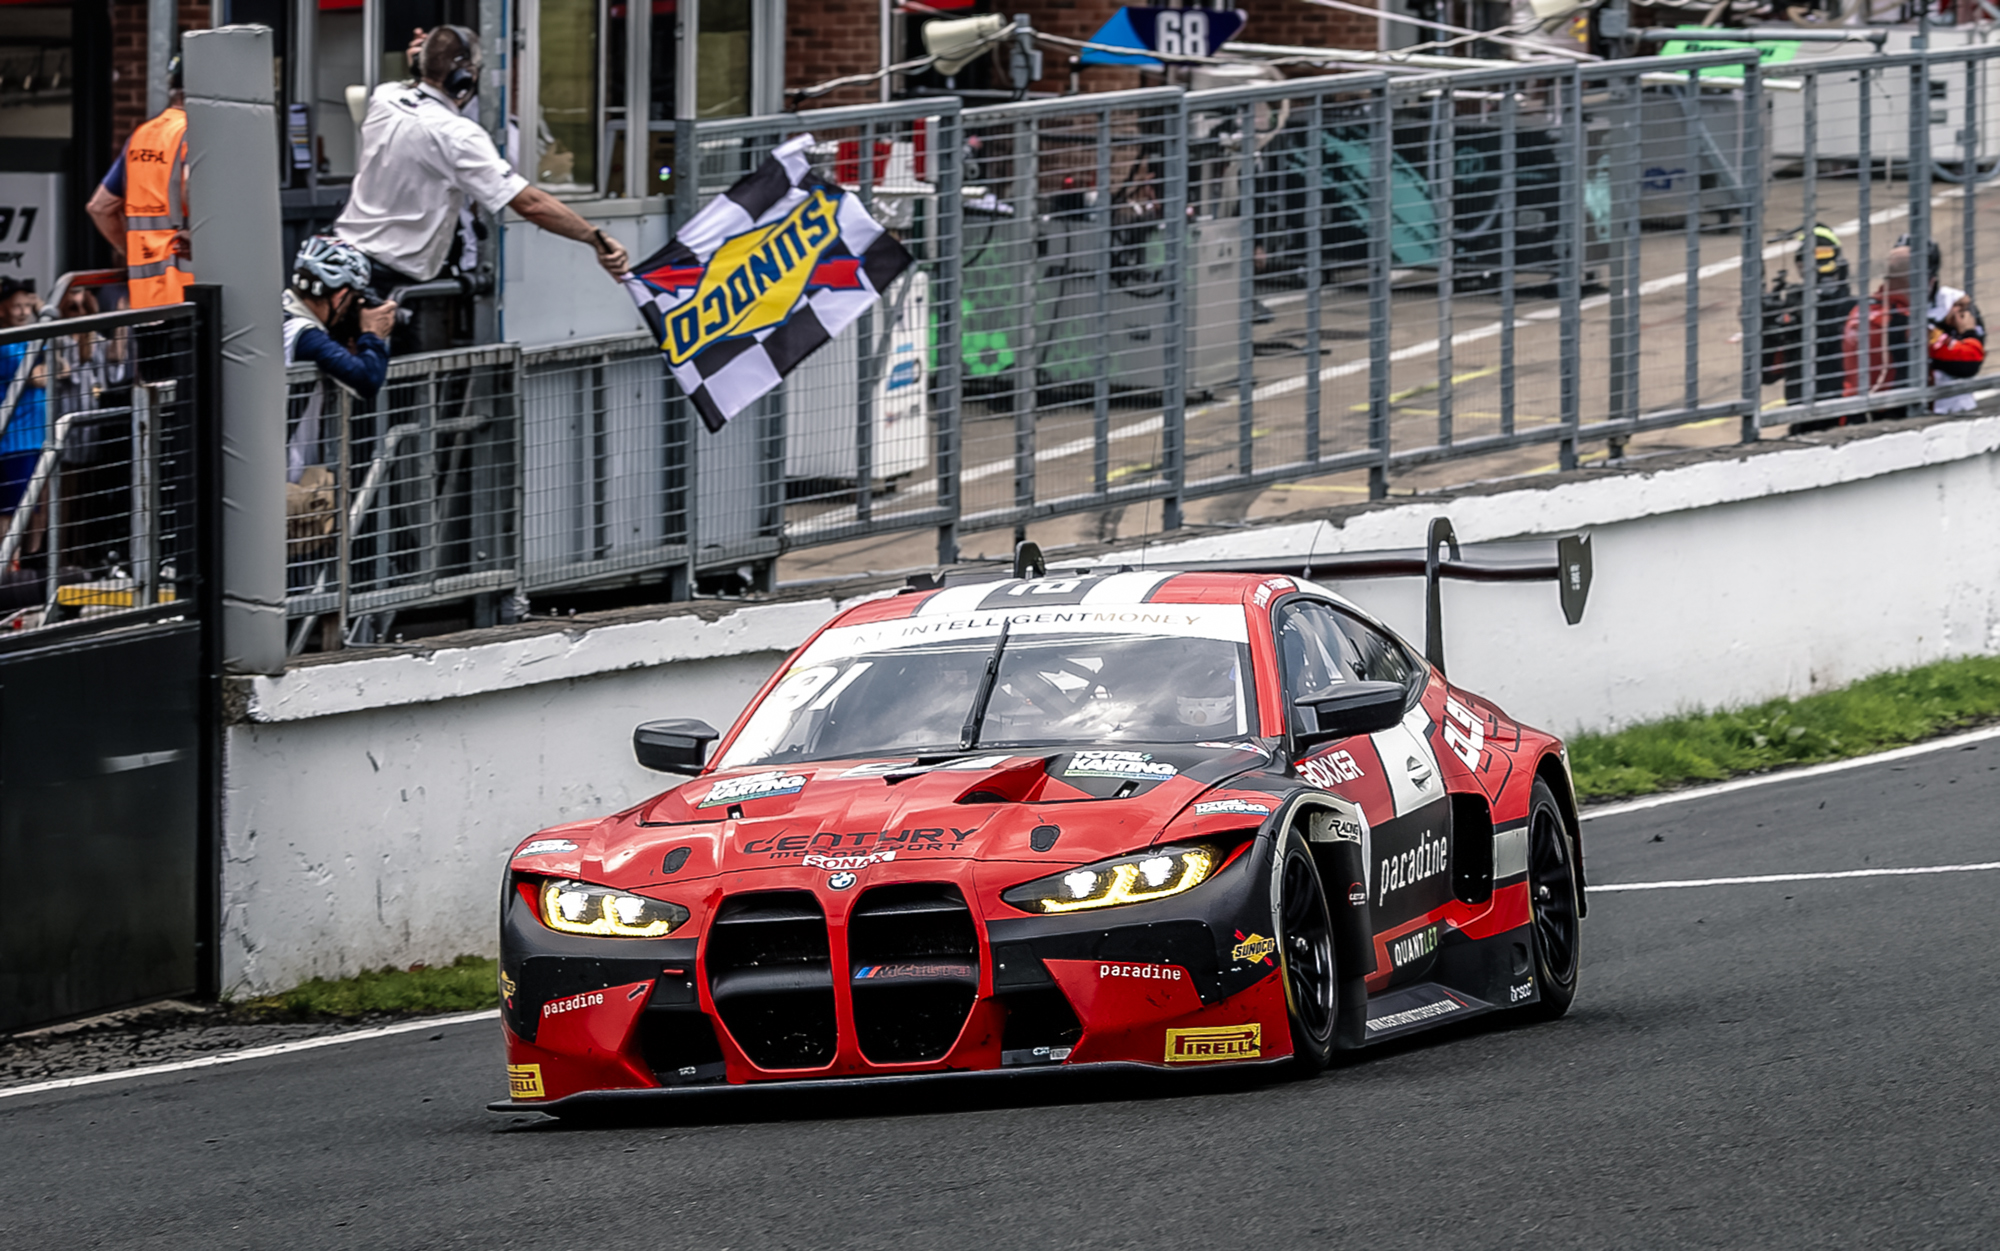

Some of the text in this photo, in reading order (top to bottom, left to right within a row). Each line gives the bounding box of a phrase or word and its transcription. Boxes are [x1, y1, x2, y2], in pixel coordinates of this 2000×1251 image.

[1155, 10, 1209, 56] 68
[671, 198, 830, 358] SUNOCO
[744, 827, 979, 855] CENTURY
[806, 852, 888, 869] SONAX
[1378, 829, 1448, 907] paradine
[1233, 938, 1275, 958] SUNOCO
[1394, 926, 1438, 967] QUANTLET
[1100, 964, 1181, 981] paradine
[543, 992, 604, 1019] paradine
[1174, 1030, 1256, 1056] PIRELLI
